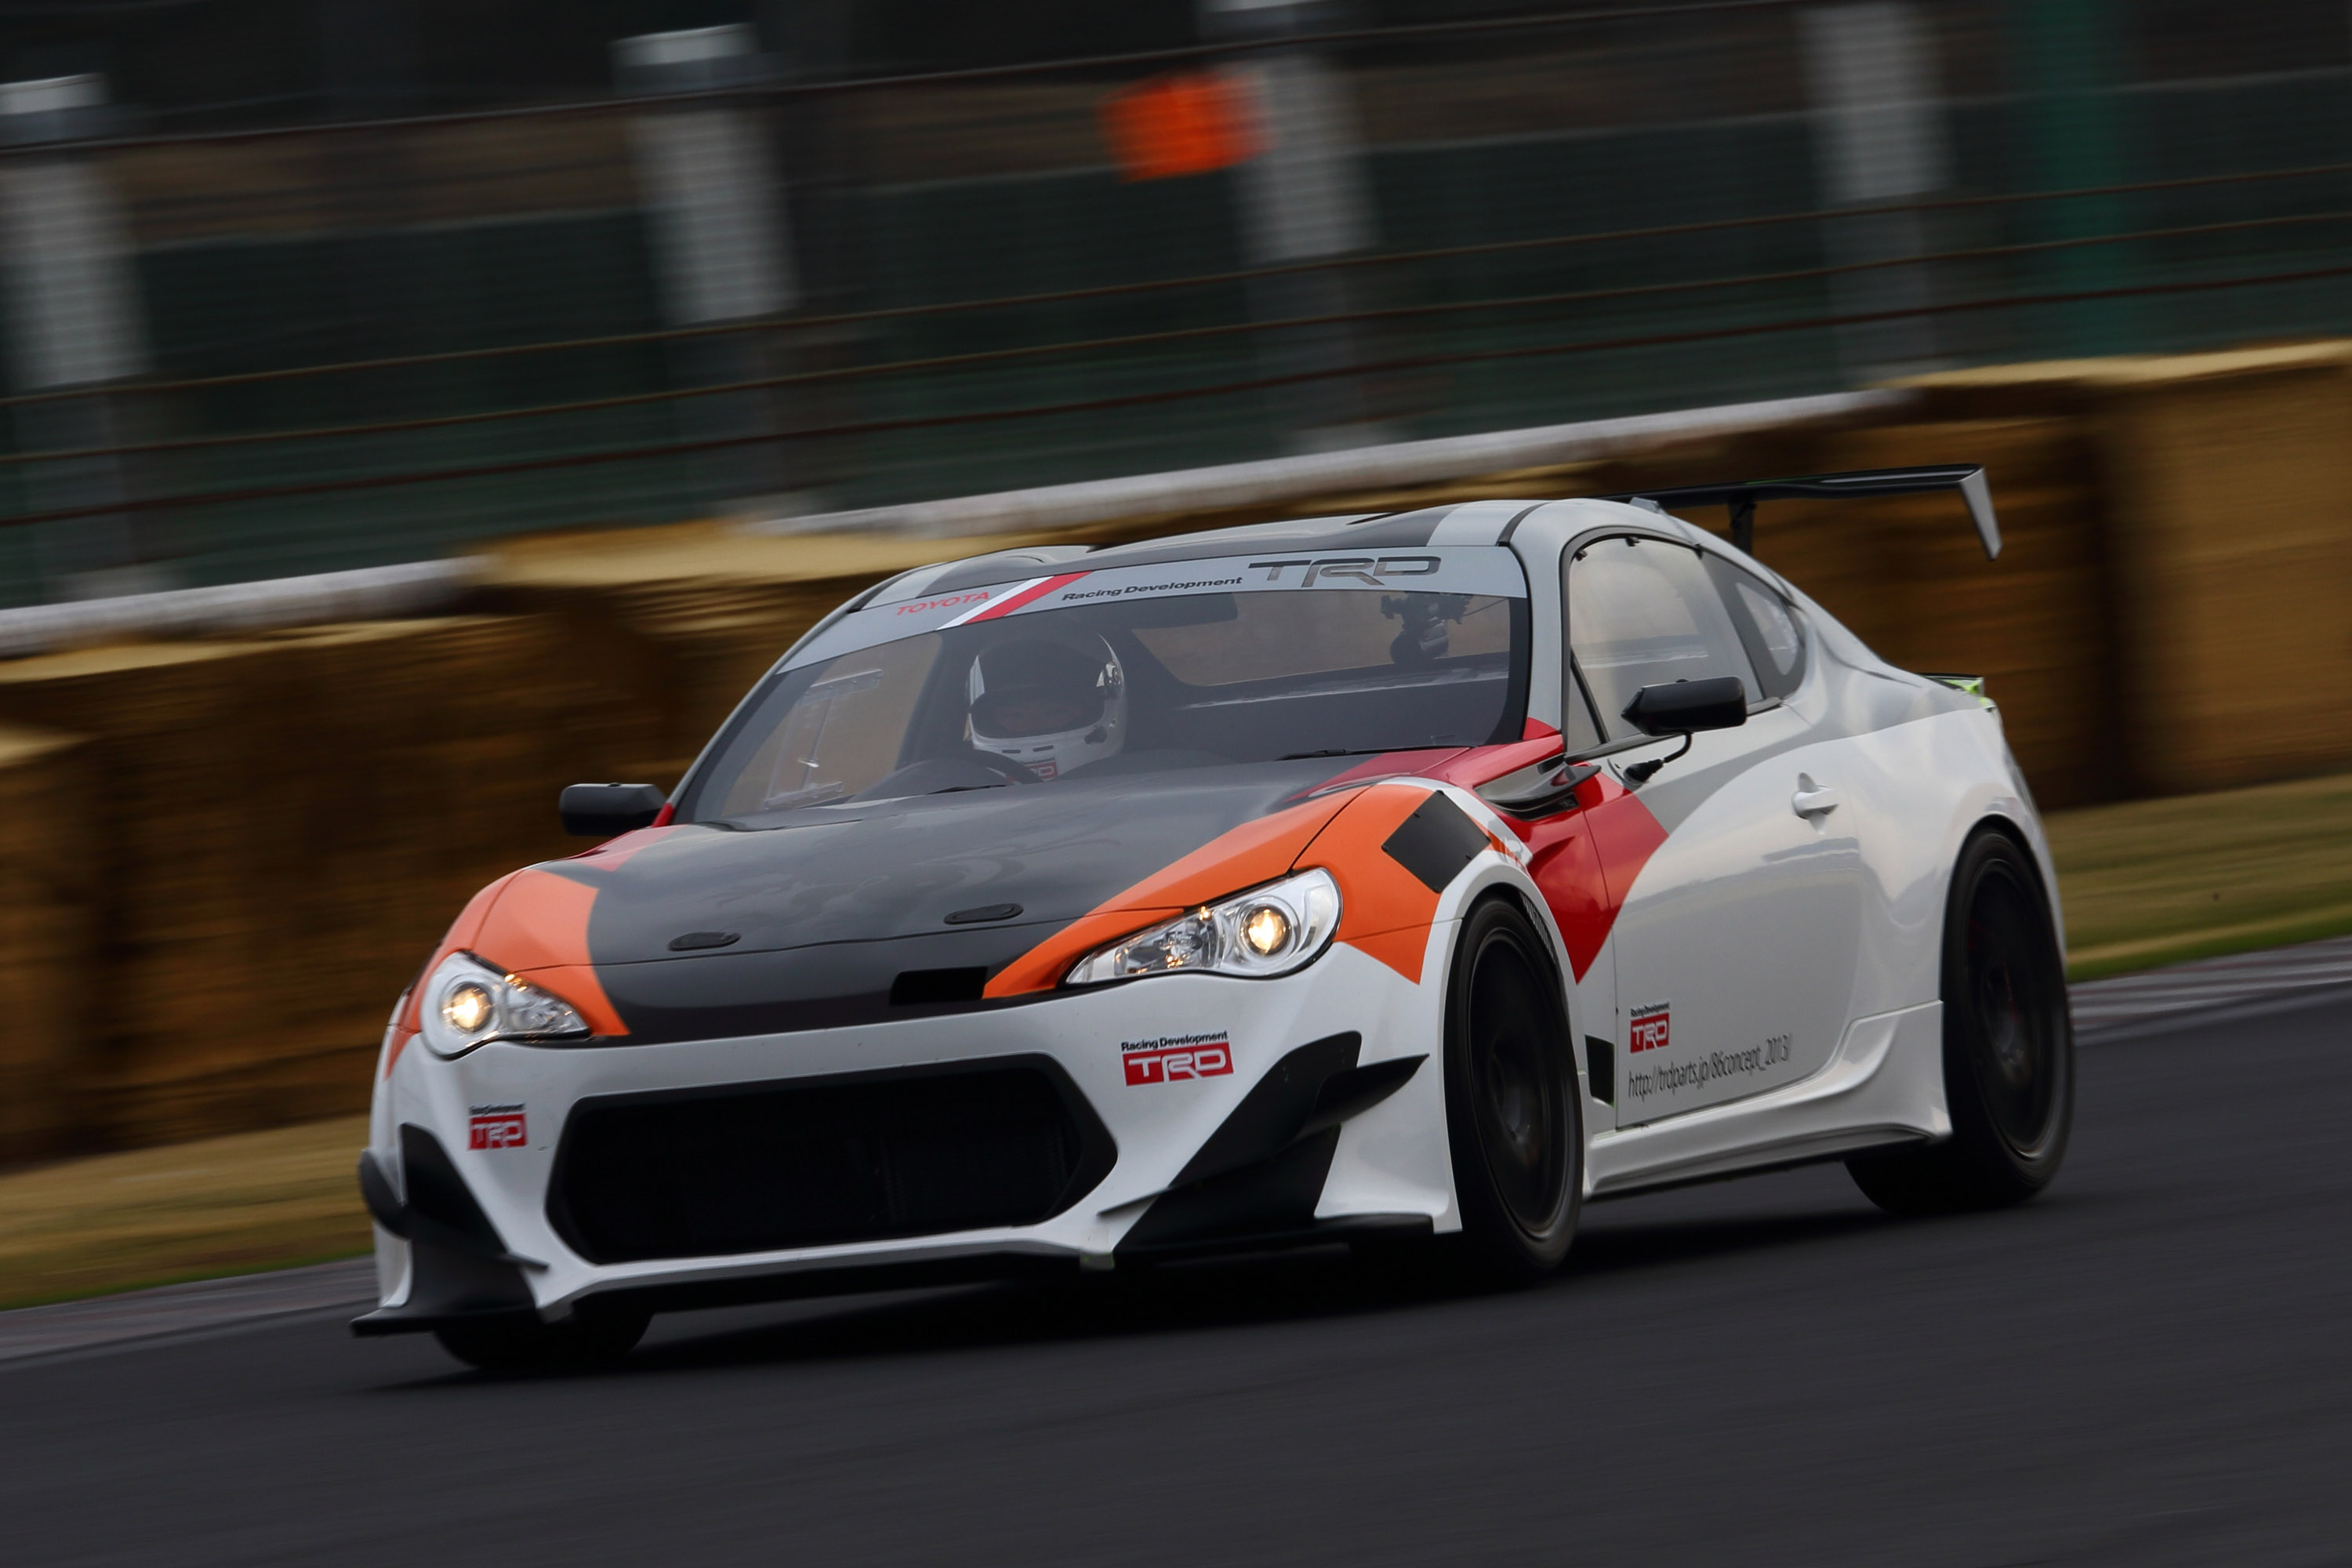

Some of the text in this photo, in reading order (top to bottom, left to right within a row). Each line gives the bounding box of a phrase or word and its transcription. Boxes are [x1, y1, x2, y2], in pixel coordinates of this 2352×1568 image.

[1248, 555, 1442, 588] TRD
[1062, 576, 1243, 601] Racing Development
[896, 591, 990, 616] TOYOTA
[1121, 1029, 1228, 1051] Racing Development
[1632, 1020, 1668, 1050] TRD
[1128, 1048, 1226, 1083] TRD
[471, 1120, 523, 1149] TRD
